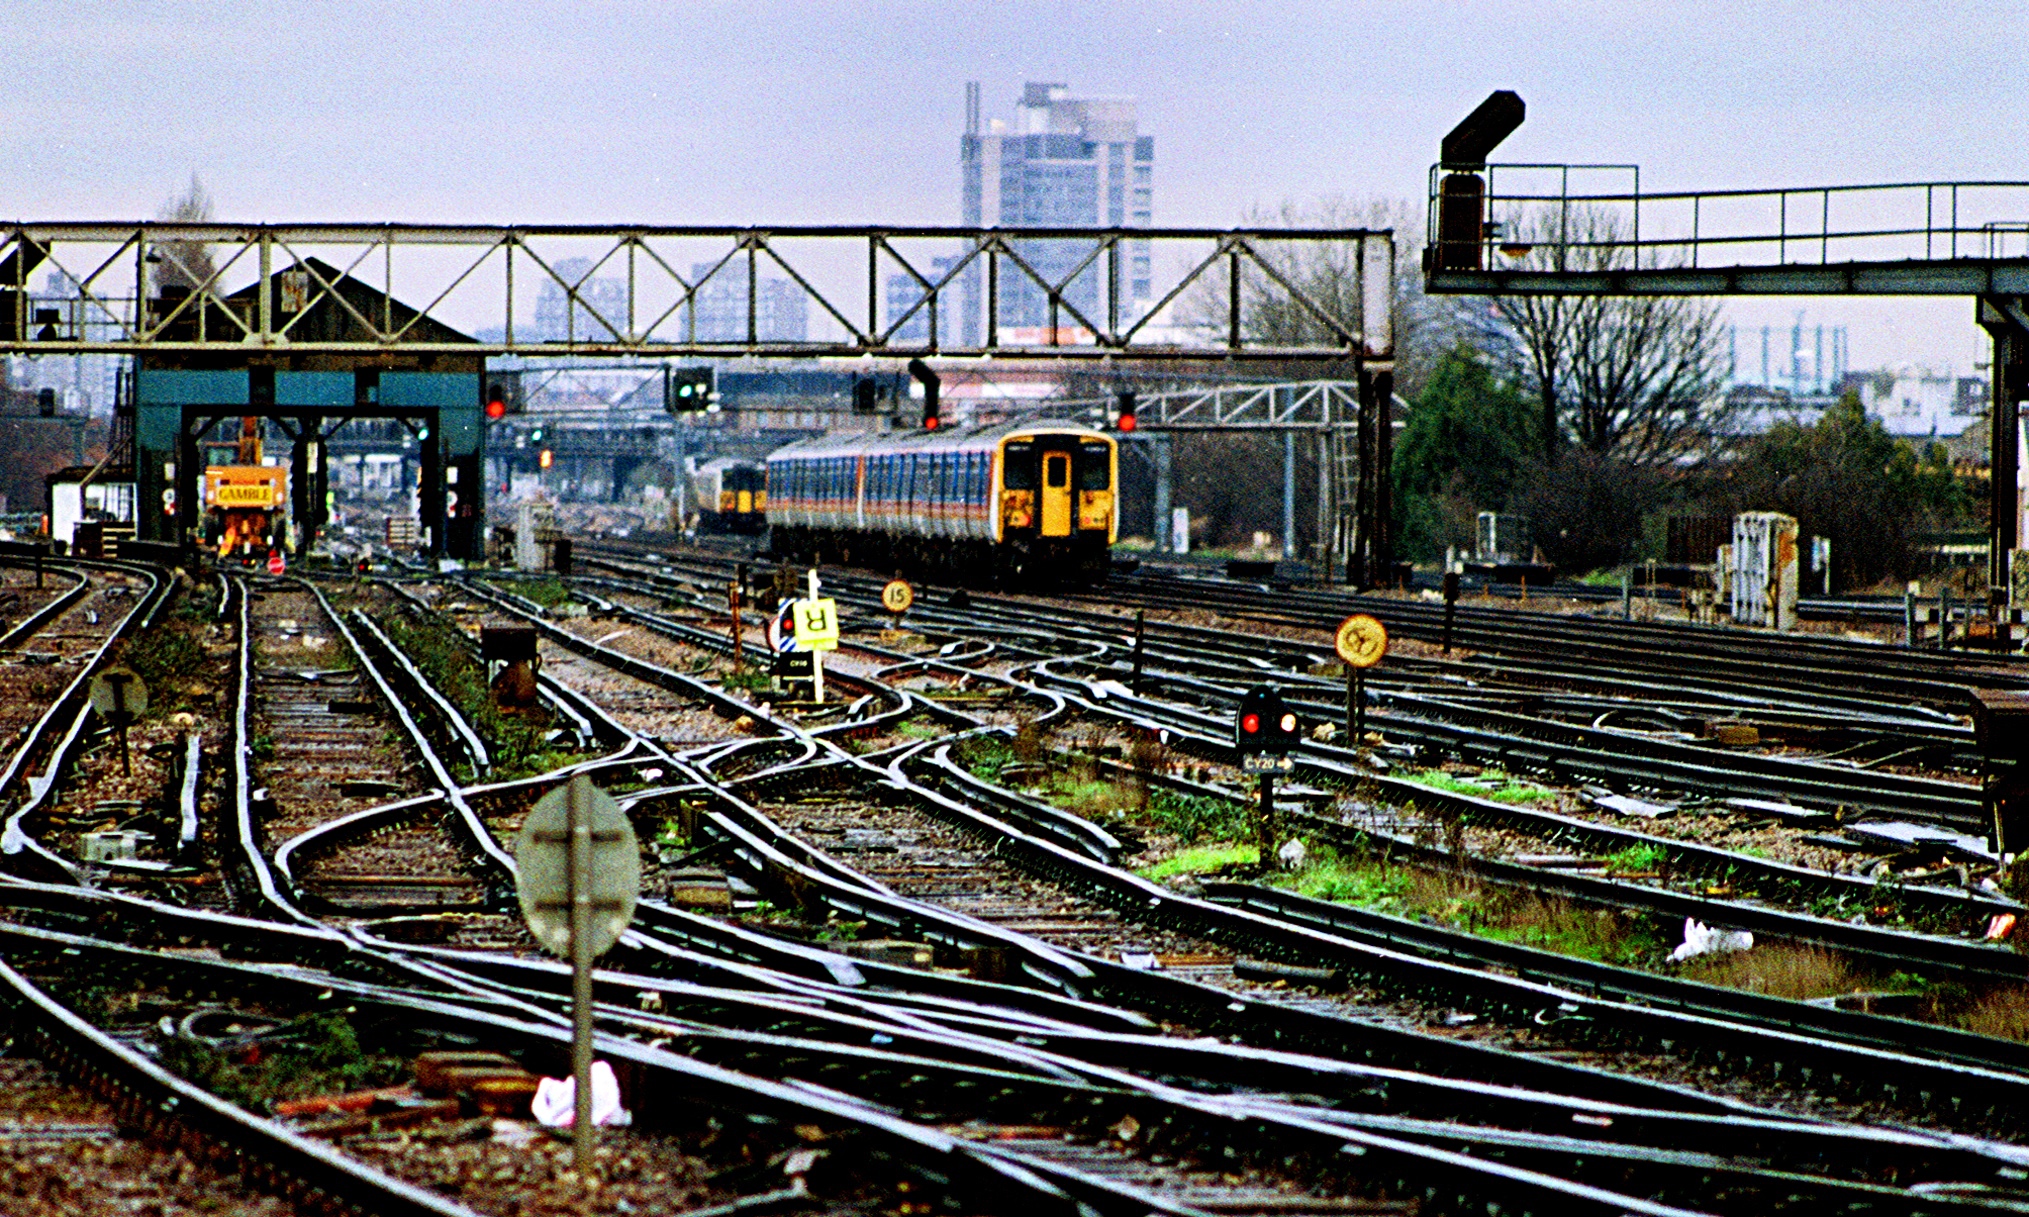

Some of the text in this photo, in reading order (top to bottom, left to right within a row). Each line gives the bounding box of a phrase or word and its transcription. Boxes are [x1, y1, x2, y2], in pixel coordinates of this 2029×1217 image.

[219, 487, 270, 501] GAMBLE
[890, 588, 905, 603] 15
[806, 609, 827, 632] R
[1245, 757, 1275, 769] CY20
